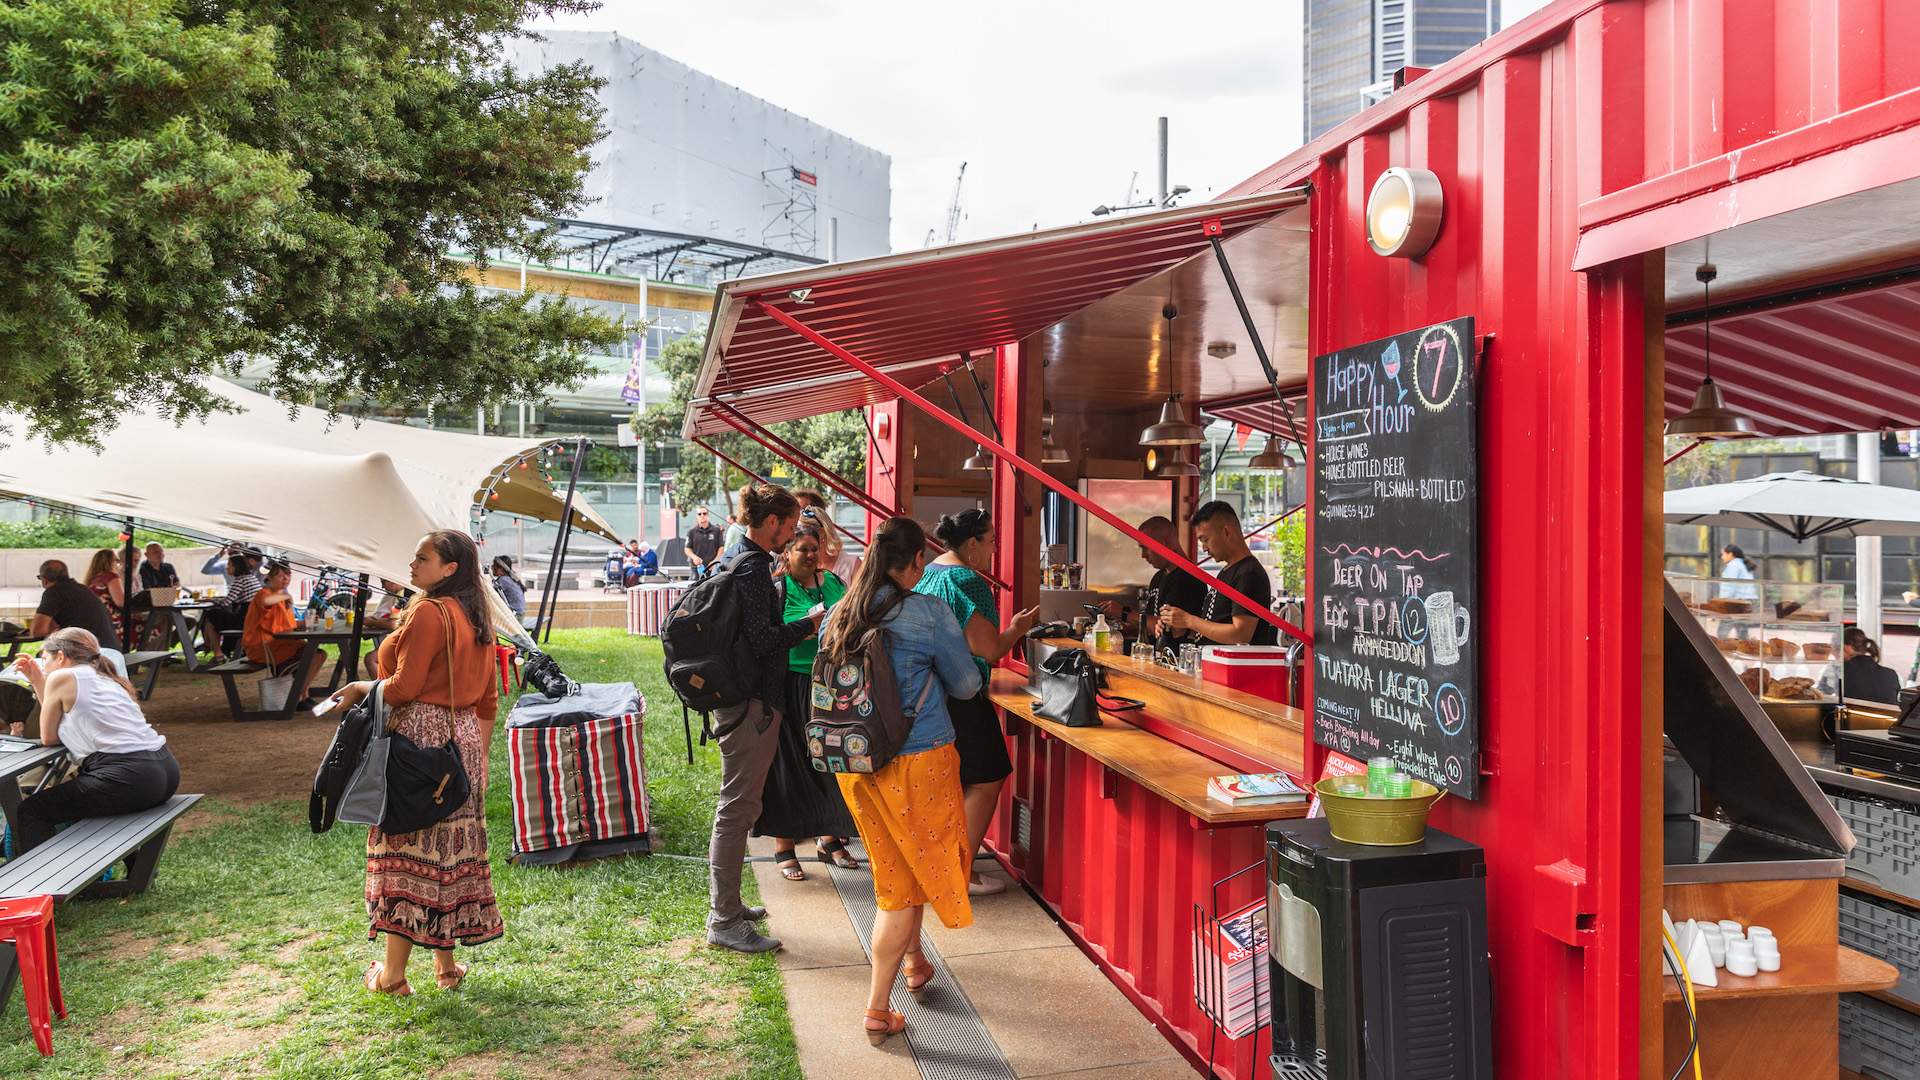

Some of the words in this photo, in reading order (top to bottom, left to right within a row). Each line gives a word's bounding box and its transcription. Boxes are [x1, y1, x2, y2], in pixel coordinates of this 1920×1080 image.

[1327, 354, 1377, 408] Happy
[1424, 337, 1447, 398] 7
[1372, 384, 1415, 435] Hour
[1326, 445, 1345, 463] HOUSE
[1347, 443, 1369, 459] WINES
[1326, 463, 1346, 480] HOUSE
[1347, 459, 1381, 479] BOTTLED
[1383, 457, 1406, 477] BEER
[1326, 504, 1357, 519] GUINNESS
[1405, 609, 1425, 635] 12
[1352, 638, 1426, 669] ARMAGEDDON
[1318, 654, 1375, 692] TUATARA
[1379, 670, 1433, 712] LAGER
[1439, 694, 1460, 726] 10
[1370, 697, 1427, 736] HELLUVA
[1323, 731, 1339, 748] XPA
[1334, 719, 1360, 746] Brewing
[1394, 739, 1414, 760] Eight
[1415, 746, 1439, 767] Wired
[1429, 766, 1447, 786] Pale
[1447, 763, 1459, 778] 10
